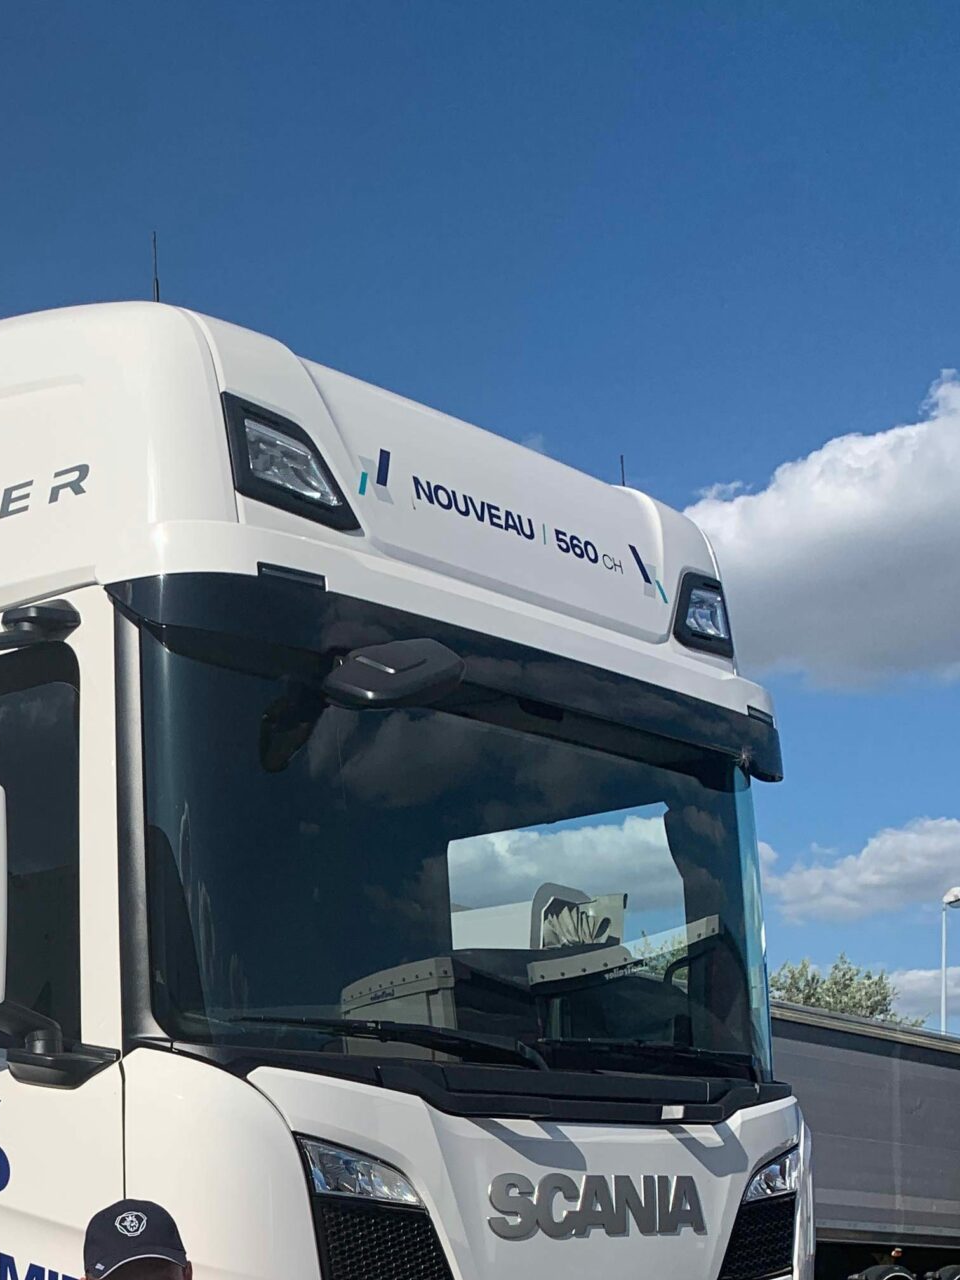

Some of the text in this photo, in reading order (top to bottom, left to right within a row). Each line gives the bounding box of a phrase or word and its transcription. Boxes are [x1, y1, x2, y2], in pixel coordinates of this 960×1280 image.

[411, 475, 624, 575] NOUVEAU 560 CH
[487, 1172, 708, 1241] SCANIA
